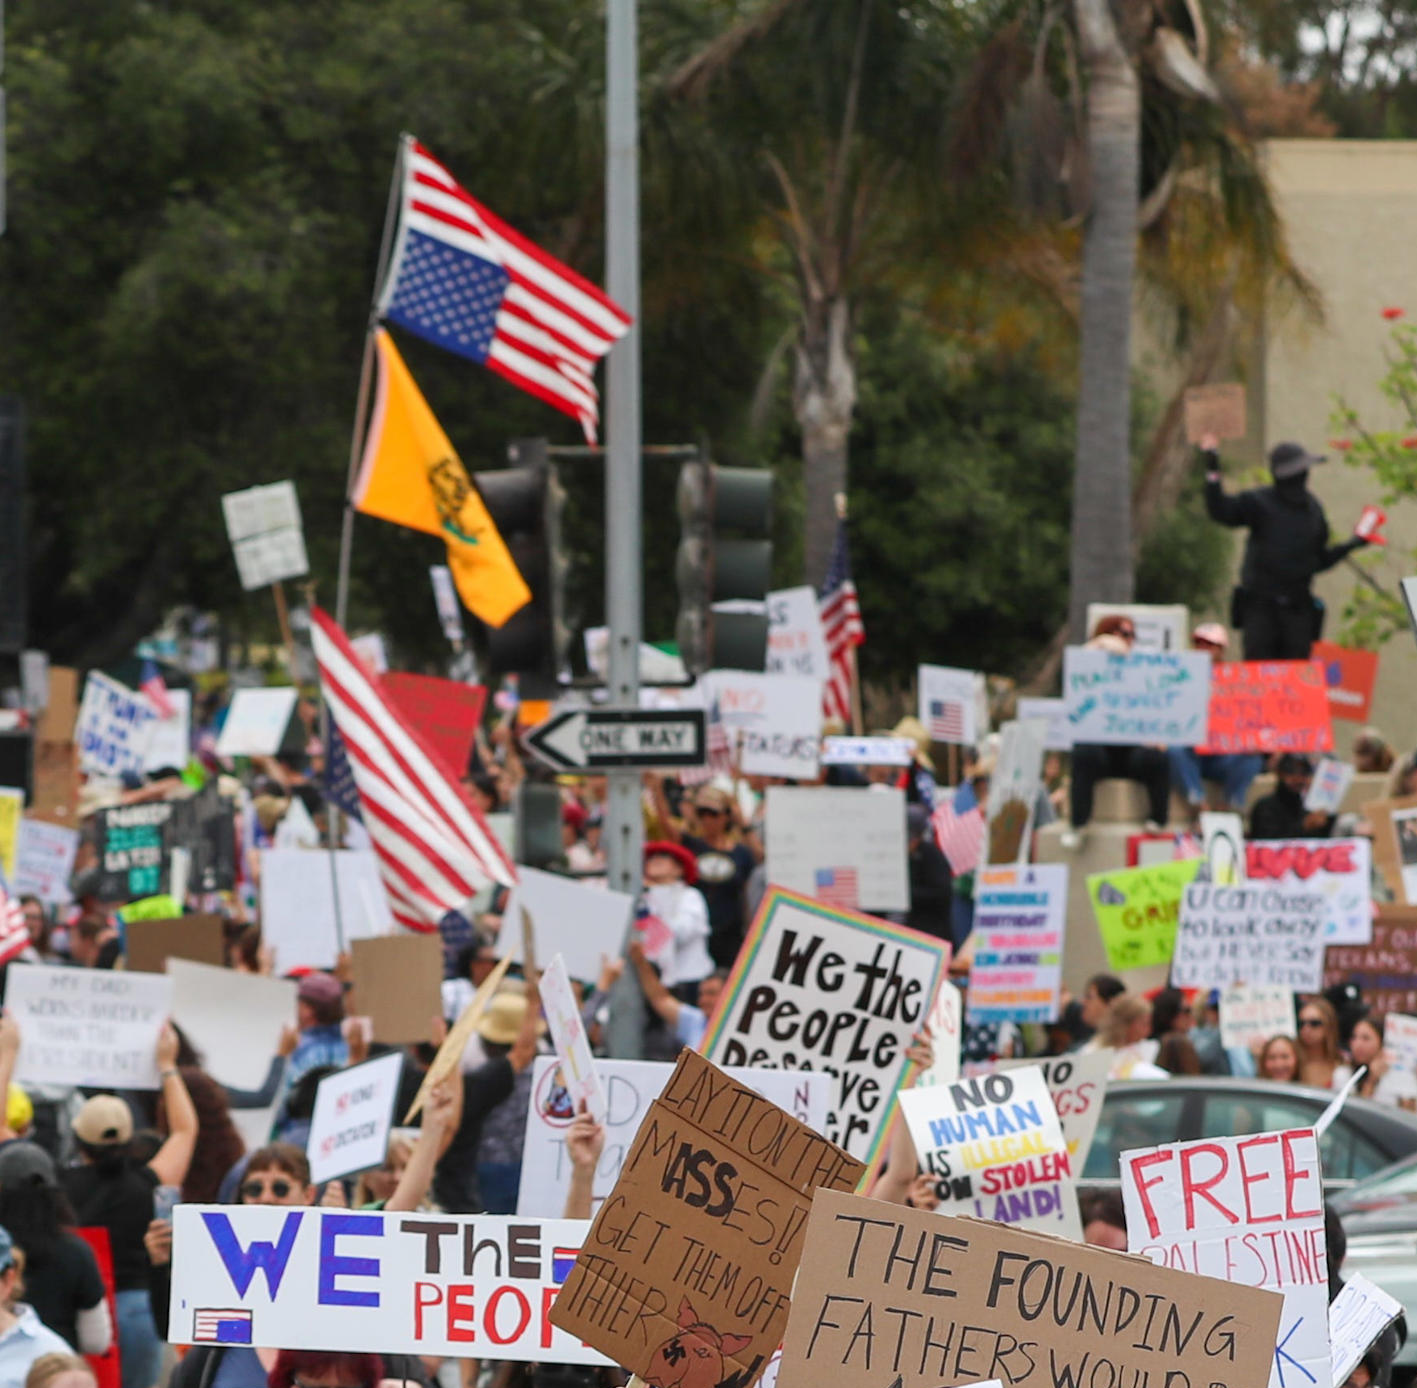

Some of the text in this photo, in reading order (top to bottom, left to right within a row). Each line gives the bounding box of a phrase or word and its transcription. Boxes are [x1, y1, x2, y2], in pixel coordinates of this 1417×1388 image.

[579, 725, 686, 749] ONE WAY
[1245, 844, 1357, 880] LOVE
[1211, 915, 1258, 938] look
[771, 928, 846, 993] We
[853, 942, 922, 1024] the
[664, 1052, 727, 1124] LAY
[714, 1088, 767, 1143] IT
[747, 1106, 798, 1169] ON
[790, 1130, 860, 1195] THE
[928, 1100, 1044, 1147] HUMAN
[948, 1074, 1014, 1112] NO
[925, 1132, 1054, 1178] IS ILLEGAL
[935, 1152, 1072, 1202] ON STOLEN
[1129, 1128, 1324, 1239] FREE
[200, 1211, 385, 1308] WE
[594, 1195, 791, 1335] GET THEM OFF
[835, 1213, 970, 1298] THE
[984, 1250, 1238, 1364] FOUNDING
[804, 1294, 1037, 1387] FATHERS
